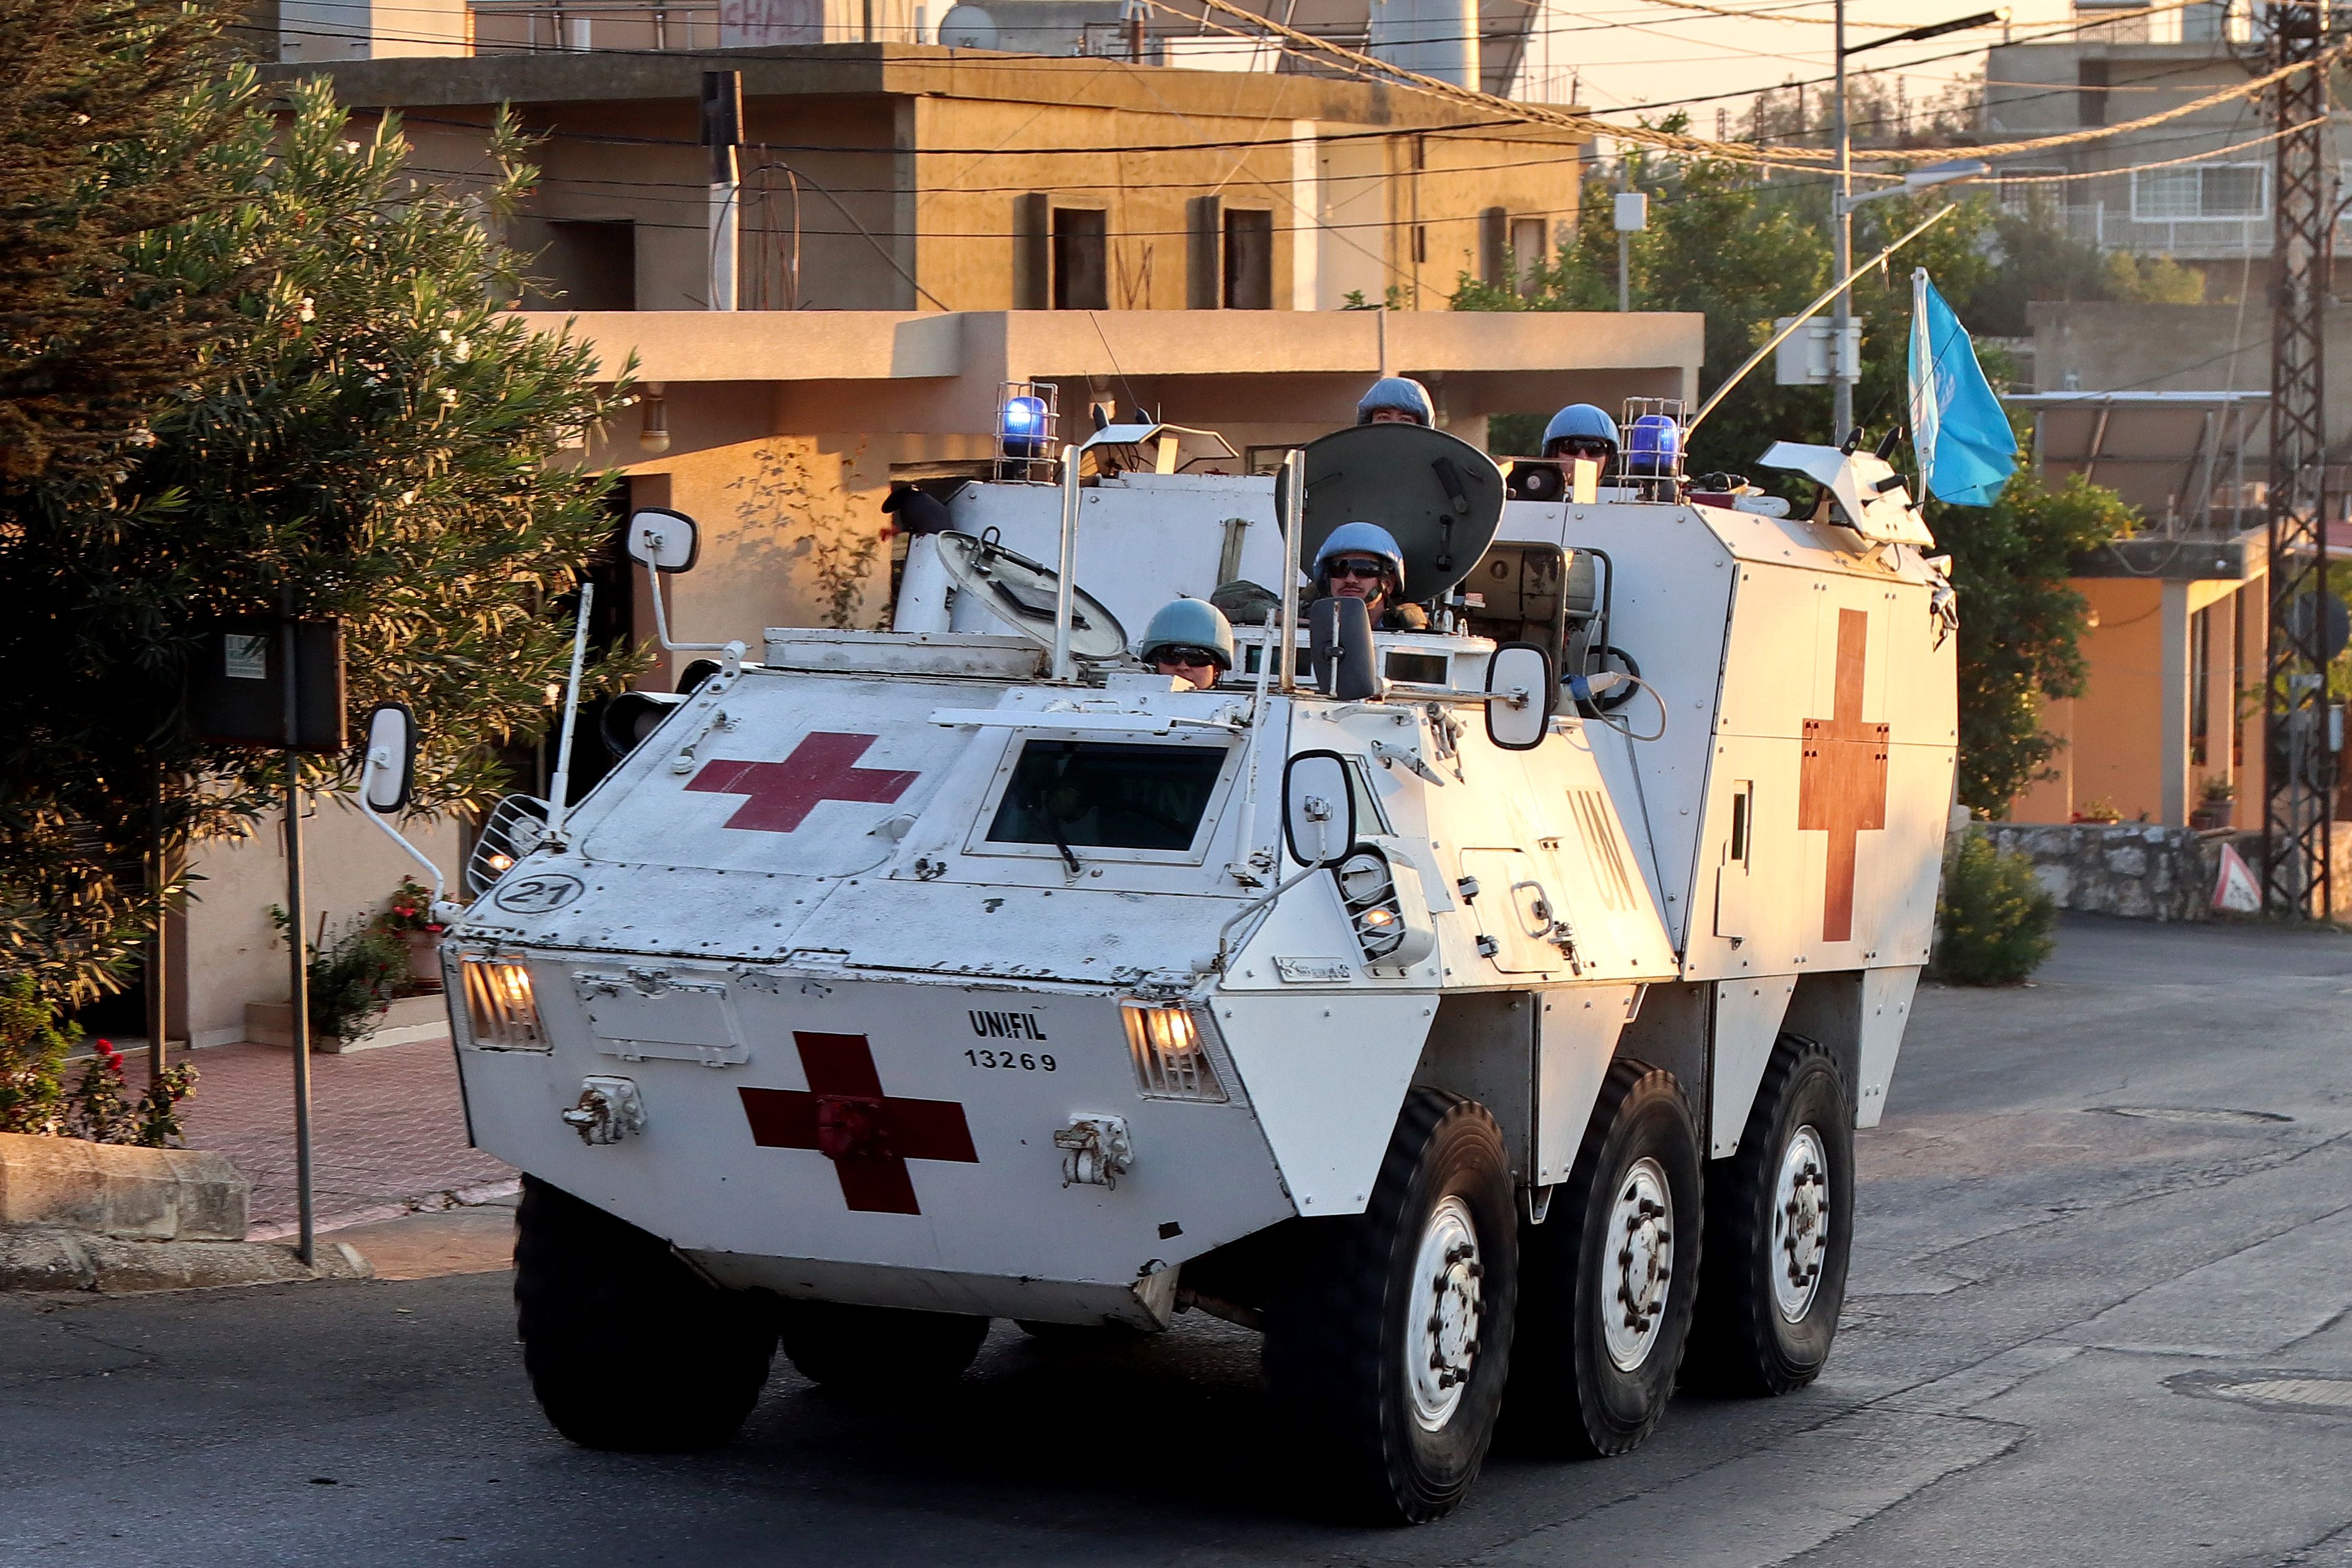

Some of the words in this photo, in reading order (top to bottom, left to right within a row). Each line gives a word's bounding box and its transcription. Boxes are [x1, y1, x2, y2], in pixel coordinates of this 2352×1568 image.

[1566, 790, 1638, 911] UN
[501, 881, 573, 904] 21
[968, 1010, 1047, 1041] UNIFIL
[964, 1049, 1057, 1072] 13269
